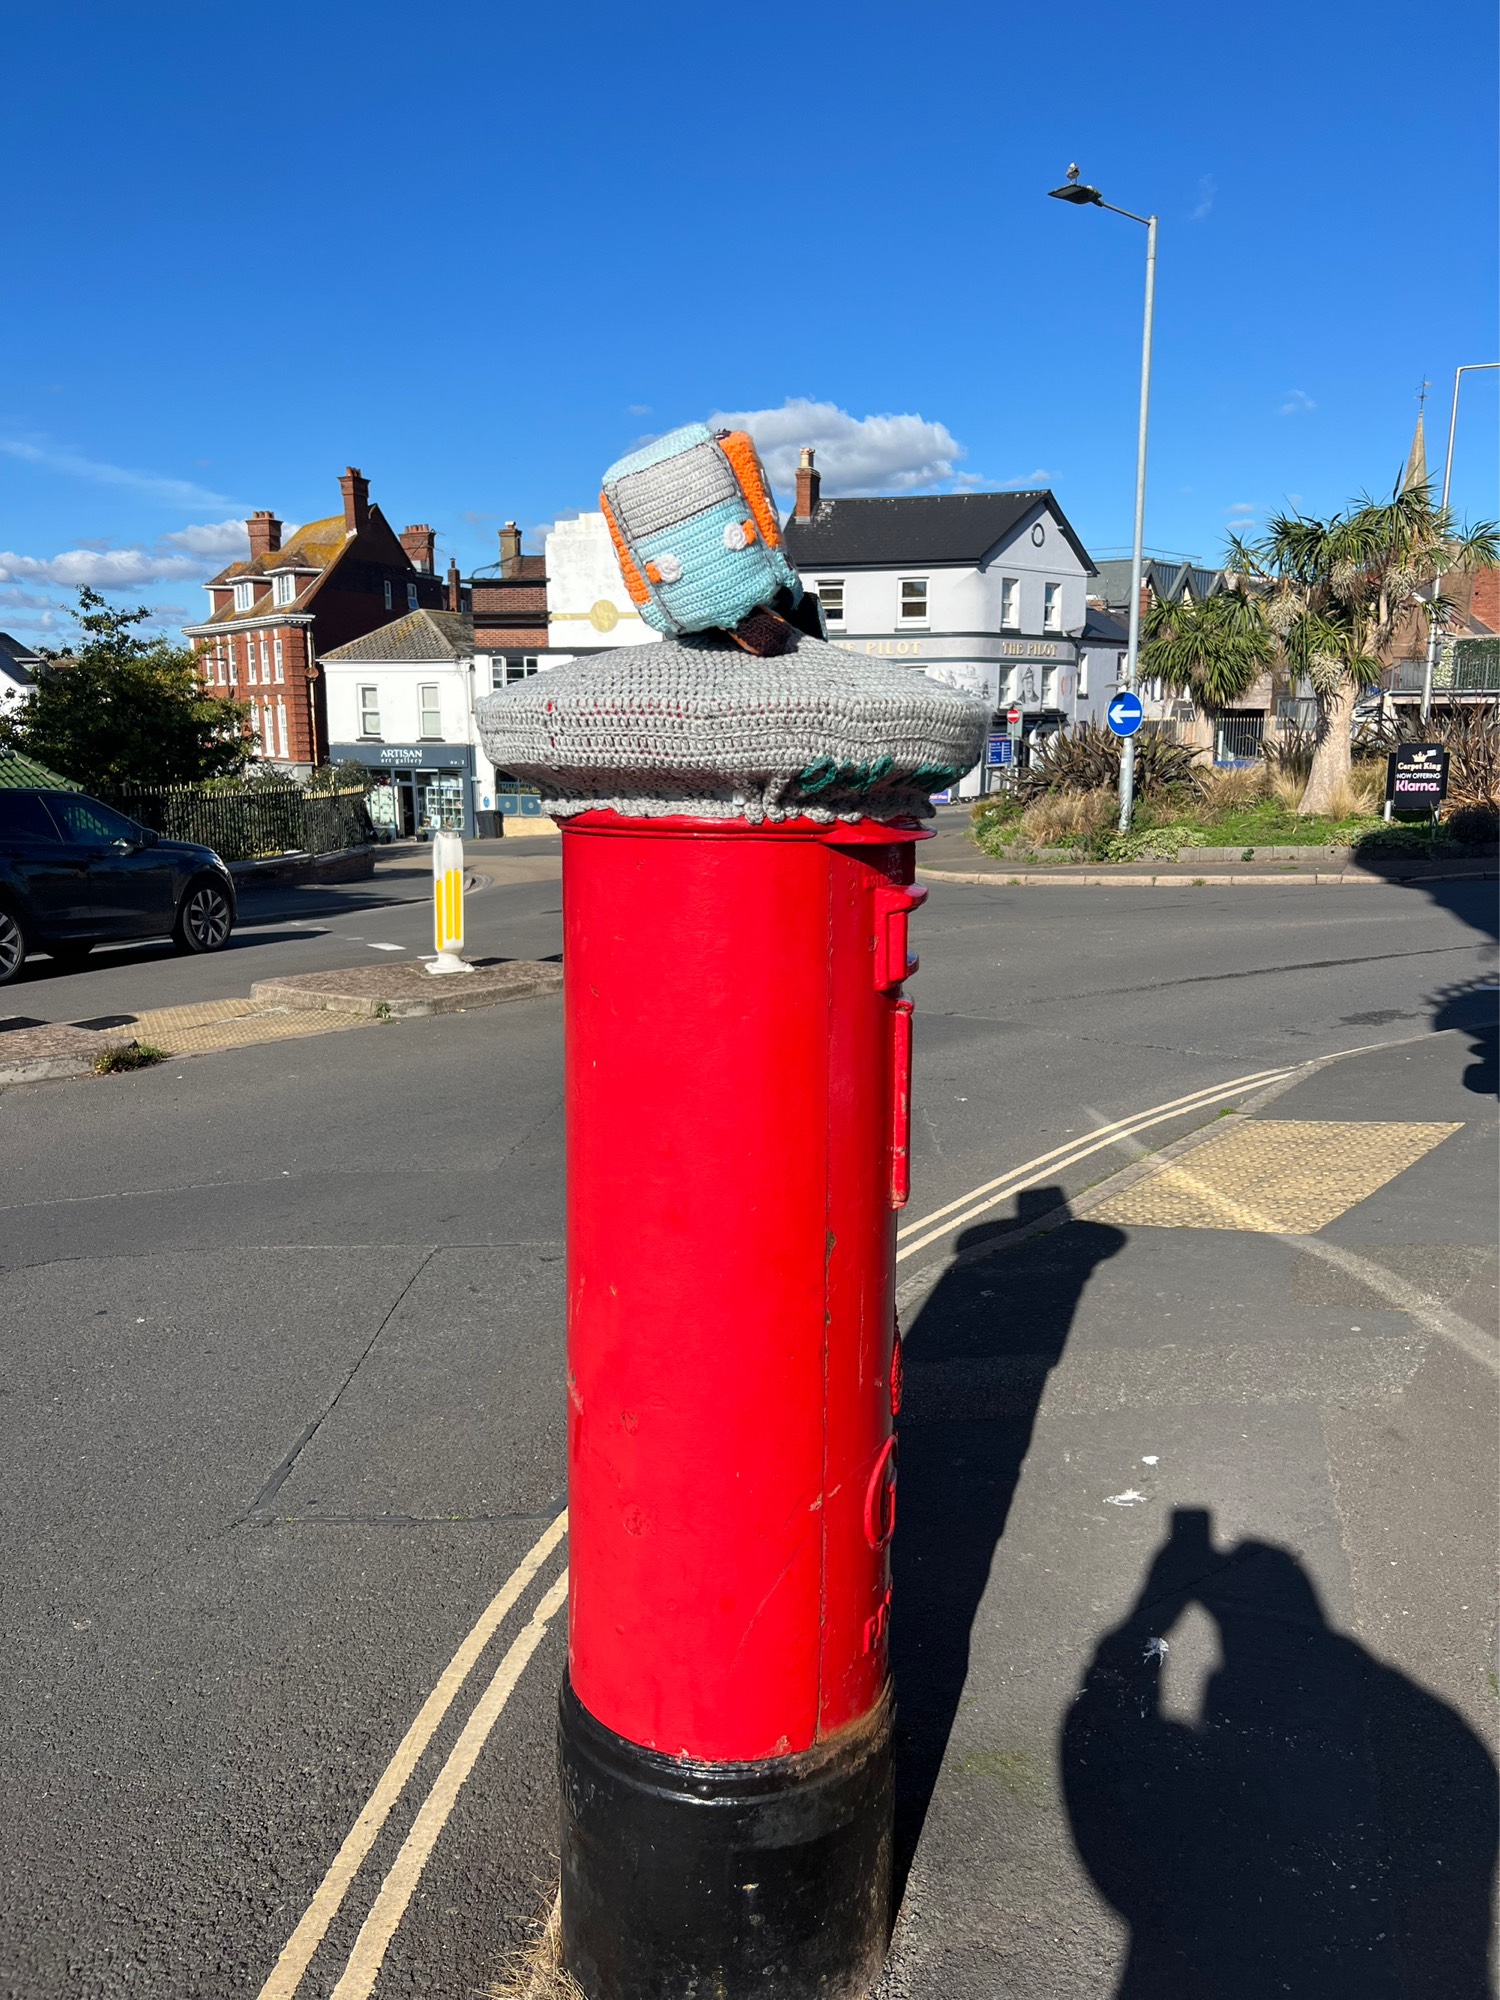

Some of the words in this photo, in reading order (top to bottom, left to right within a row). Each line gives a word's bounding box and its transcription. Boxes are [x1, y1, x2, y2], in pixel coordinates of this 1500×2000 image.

[864, 641, 921, 655] PILOT
[1002, 641, 1024, 656] THE
[1027, 642, 1057, 657] PILOT
[380, 749, 423, 758] ARTISAN
[395, 757, 423, 765] gallery
[1397, 762, 1422, 771] Carpet
[1423, 762, 1442, 771] King
[1395, 780, 1440, 791] Klarna.
